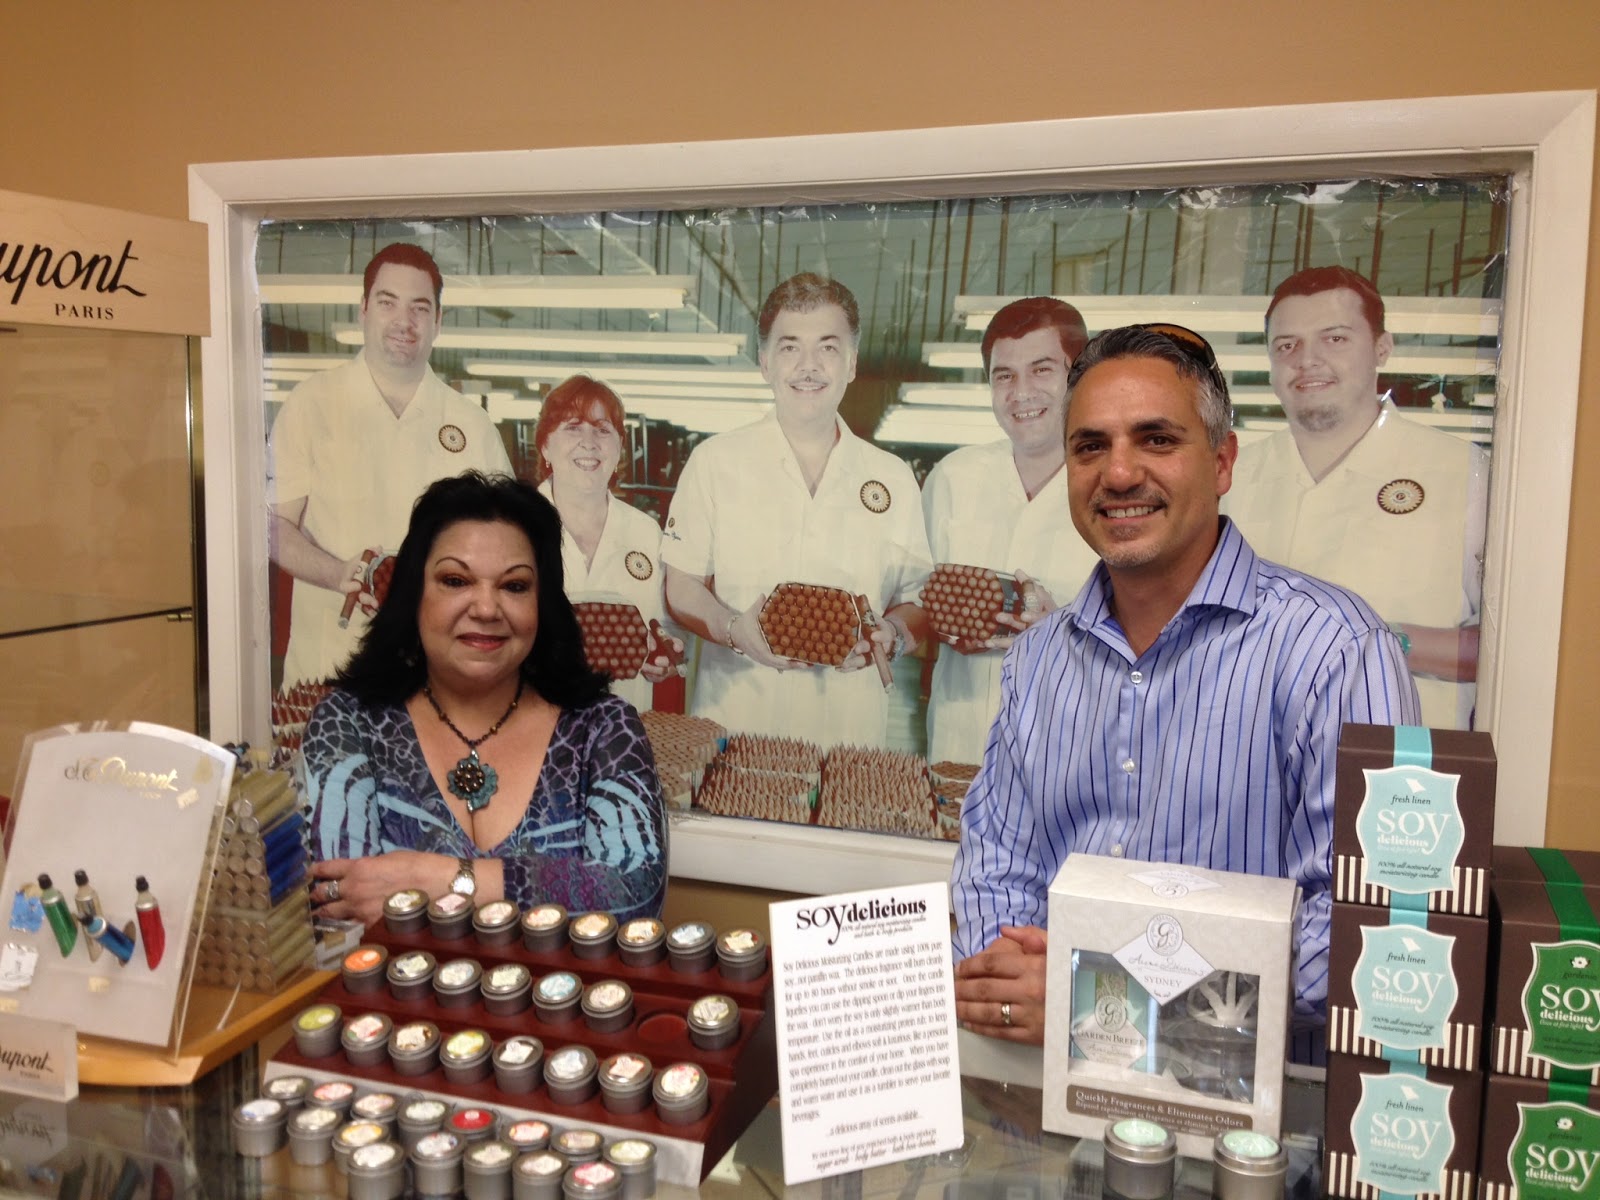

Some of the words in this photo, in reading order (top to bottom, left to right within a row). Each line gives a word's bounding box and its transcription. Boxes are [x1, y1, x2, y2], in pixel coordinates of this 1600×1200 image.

[54, 303, 114, 320] PARIS
[1390, 794, 1410, 806] fresh
[1411, 795, 1431, 806] linen
[1377, 834, 1429, 848] delicious
[1386, 952, 1405, 962] fresh
[1407, 955, 1426, 964] linen
[1144, 976, 1182, 988] SYDNEY
[1371, 990, 1423, 1005] delicious
[1540, 1009, 1594, 1024] delicious
[1077, 1028, 1112, 1042] GARDEN
[0, 1045, 54, 1073] upont
[1076, 1090, 1108, 1104] Quickly
[1110, 1096, 1155, 1113] Fragrances
[1157, 1105, 1164, 1114] &
[1167, 1106, 1213, 1122] Eliminates
[1215, 1115, 1244, 1127] Odors
[1385, 1100, 1403, 1111] fresh
[1405, 1102, 1424, 1112] linen
[1370, 1138, 1420, 1153] delicious
[1526, 1168, 1578, 1184] delicious
